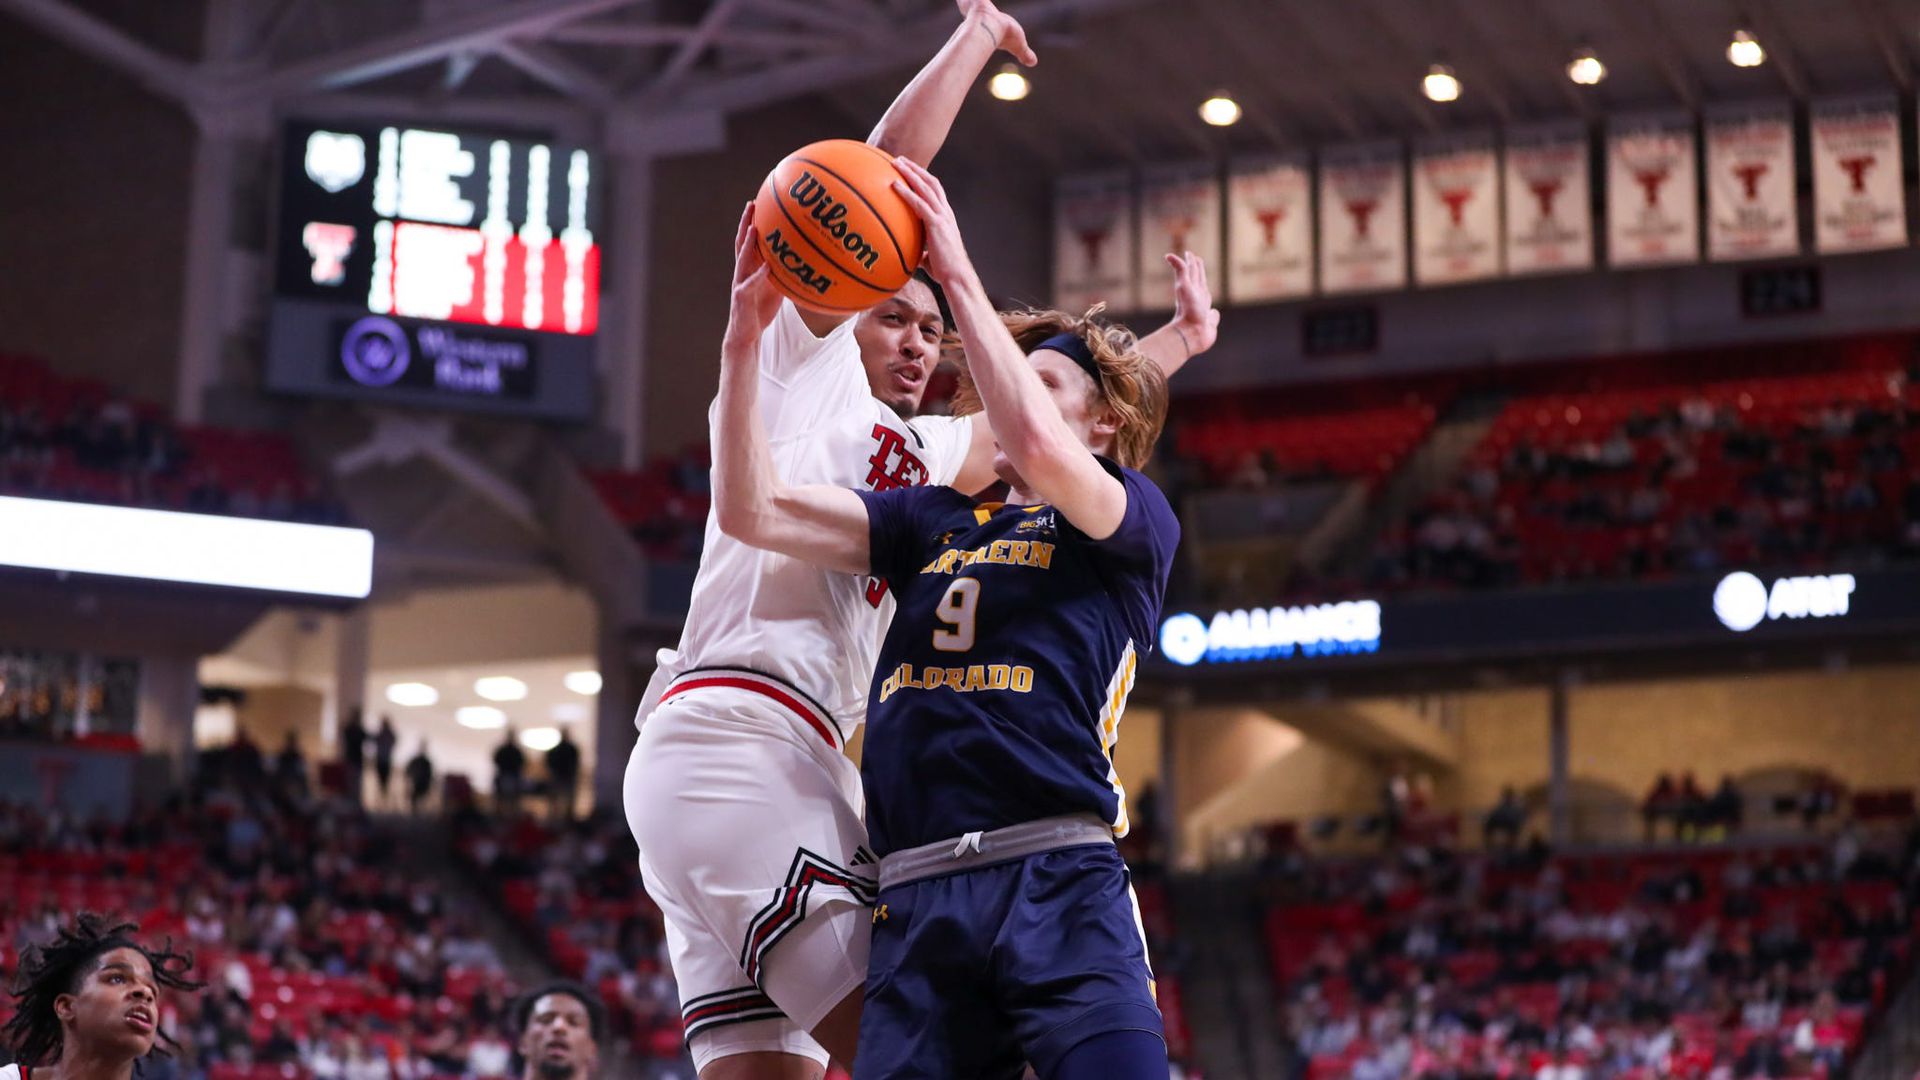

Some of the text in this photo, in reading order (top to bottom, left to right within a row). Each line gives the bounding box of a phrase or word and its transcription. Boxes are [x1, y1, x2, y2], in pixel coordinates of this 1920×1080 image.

[789, 171, 879, 270] Wilson
[765, 228, 832, 295] NCAA
[919, 539, 1056, 575] RTHERN
[932, 577, 981, 652] 9
[1208, 599, 1382, 650] ALLIANCE
